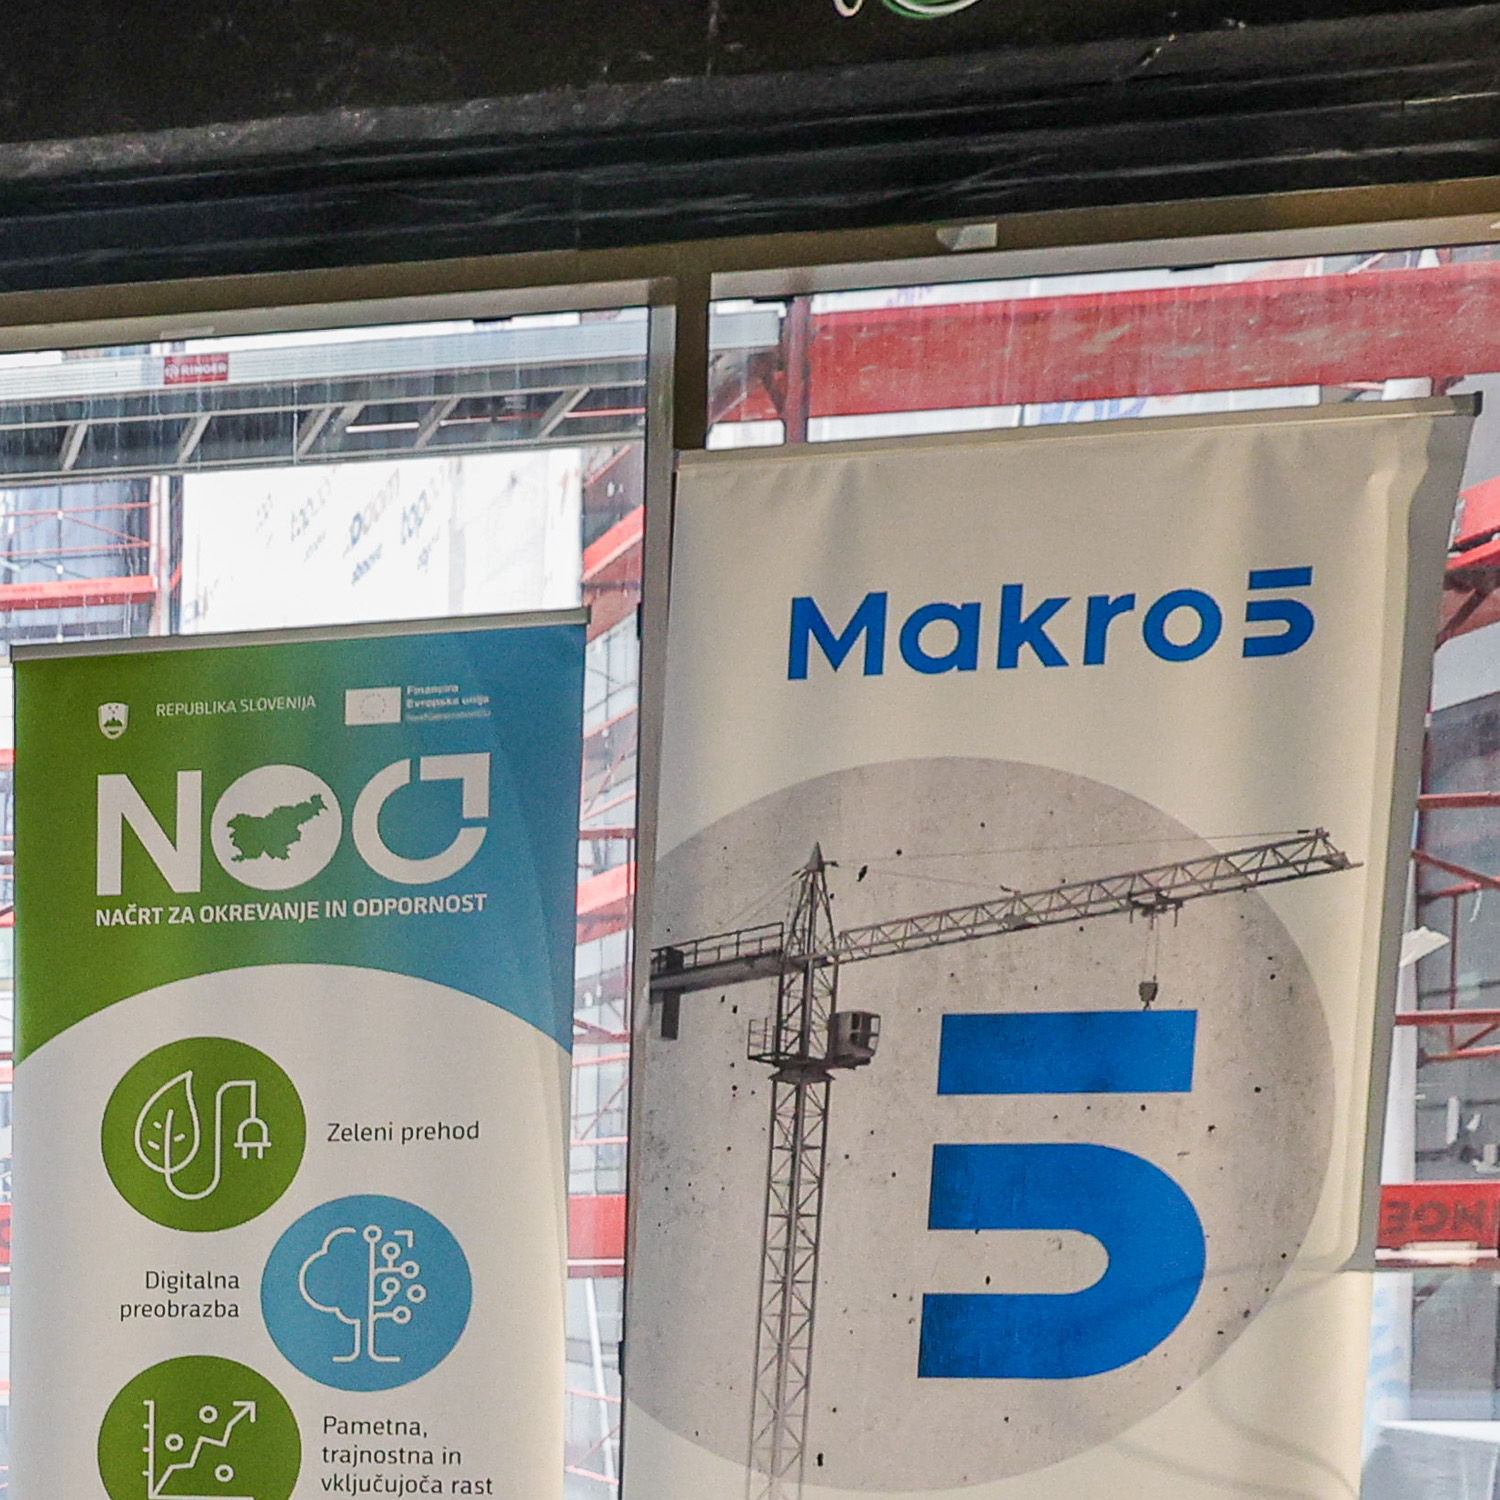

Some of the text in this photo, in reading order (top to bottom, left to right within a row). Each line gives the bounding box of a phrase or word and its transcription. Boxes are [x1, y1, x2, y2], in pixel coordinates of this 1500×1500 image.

[156, 696, 317, 717] REPUBLIKA SLOVENIJA
[96, 893, 488, 927] NAČRT ZA OKREVANJE IN ODPORNOST
[326, 1121, 480, 1148] Zeleni prehod
[144, 1269, 240, 1294] Digitalna
[119, 1299, 240, 1321] preobrazba
[322, 1415, 428, 1439] Pametna,
[321, 1445, 462, 1470] trajnostna in
[321, 1473, 494, 1500] vključujoča rast
